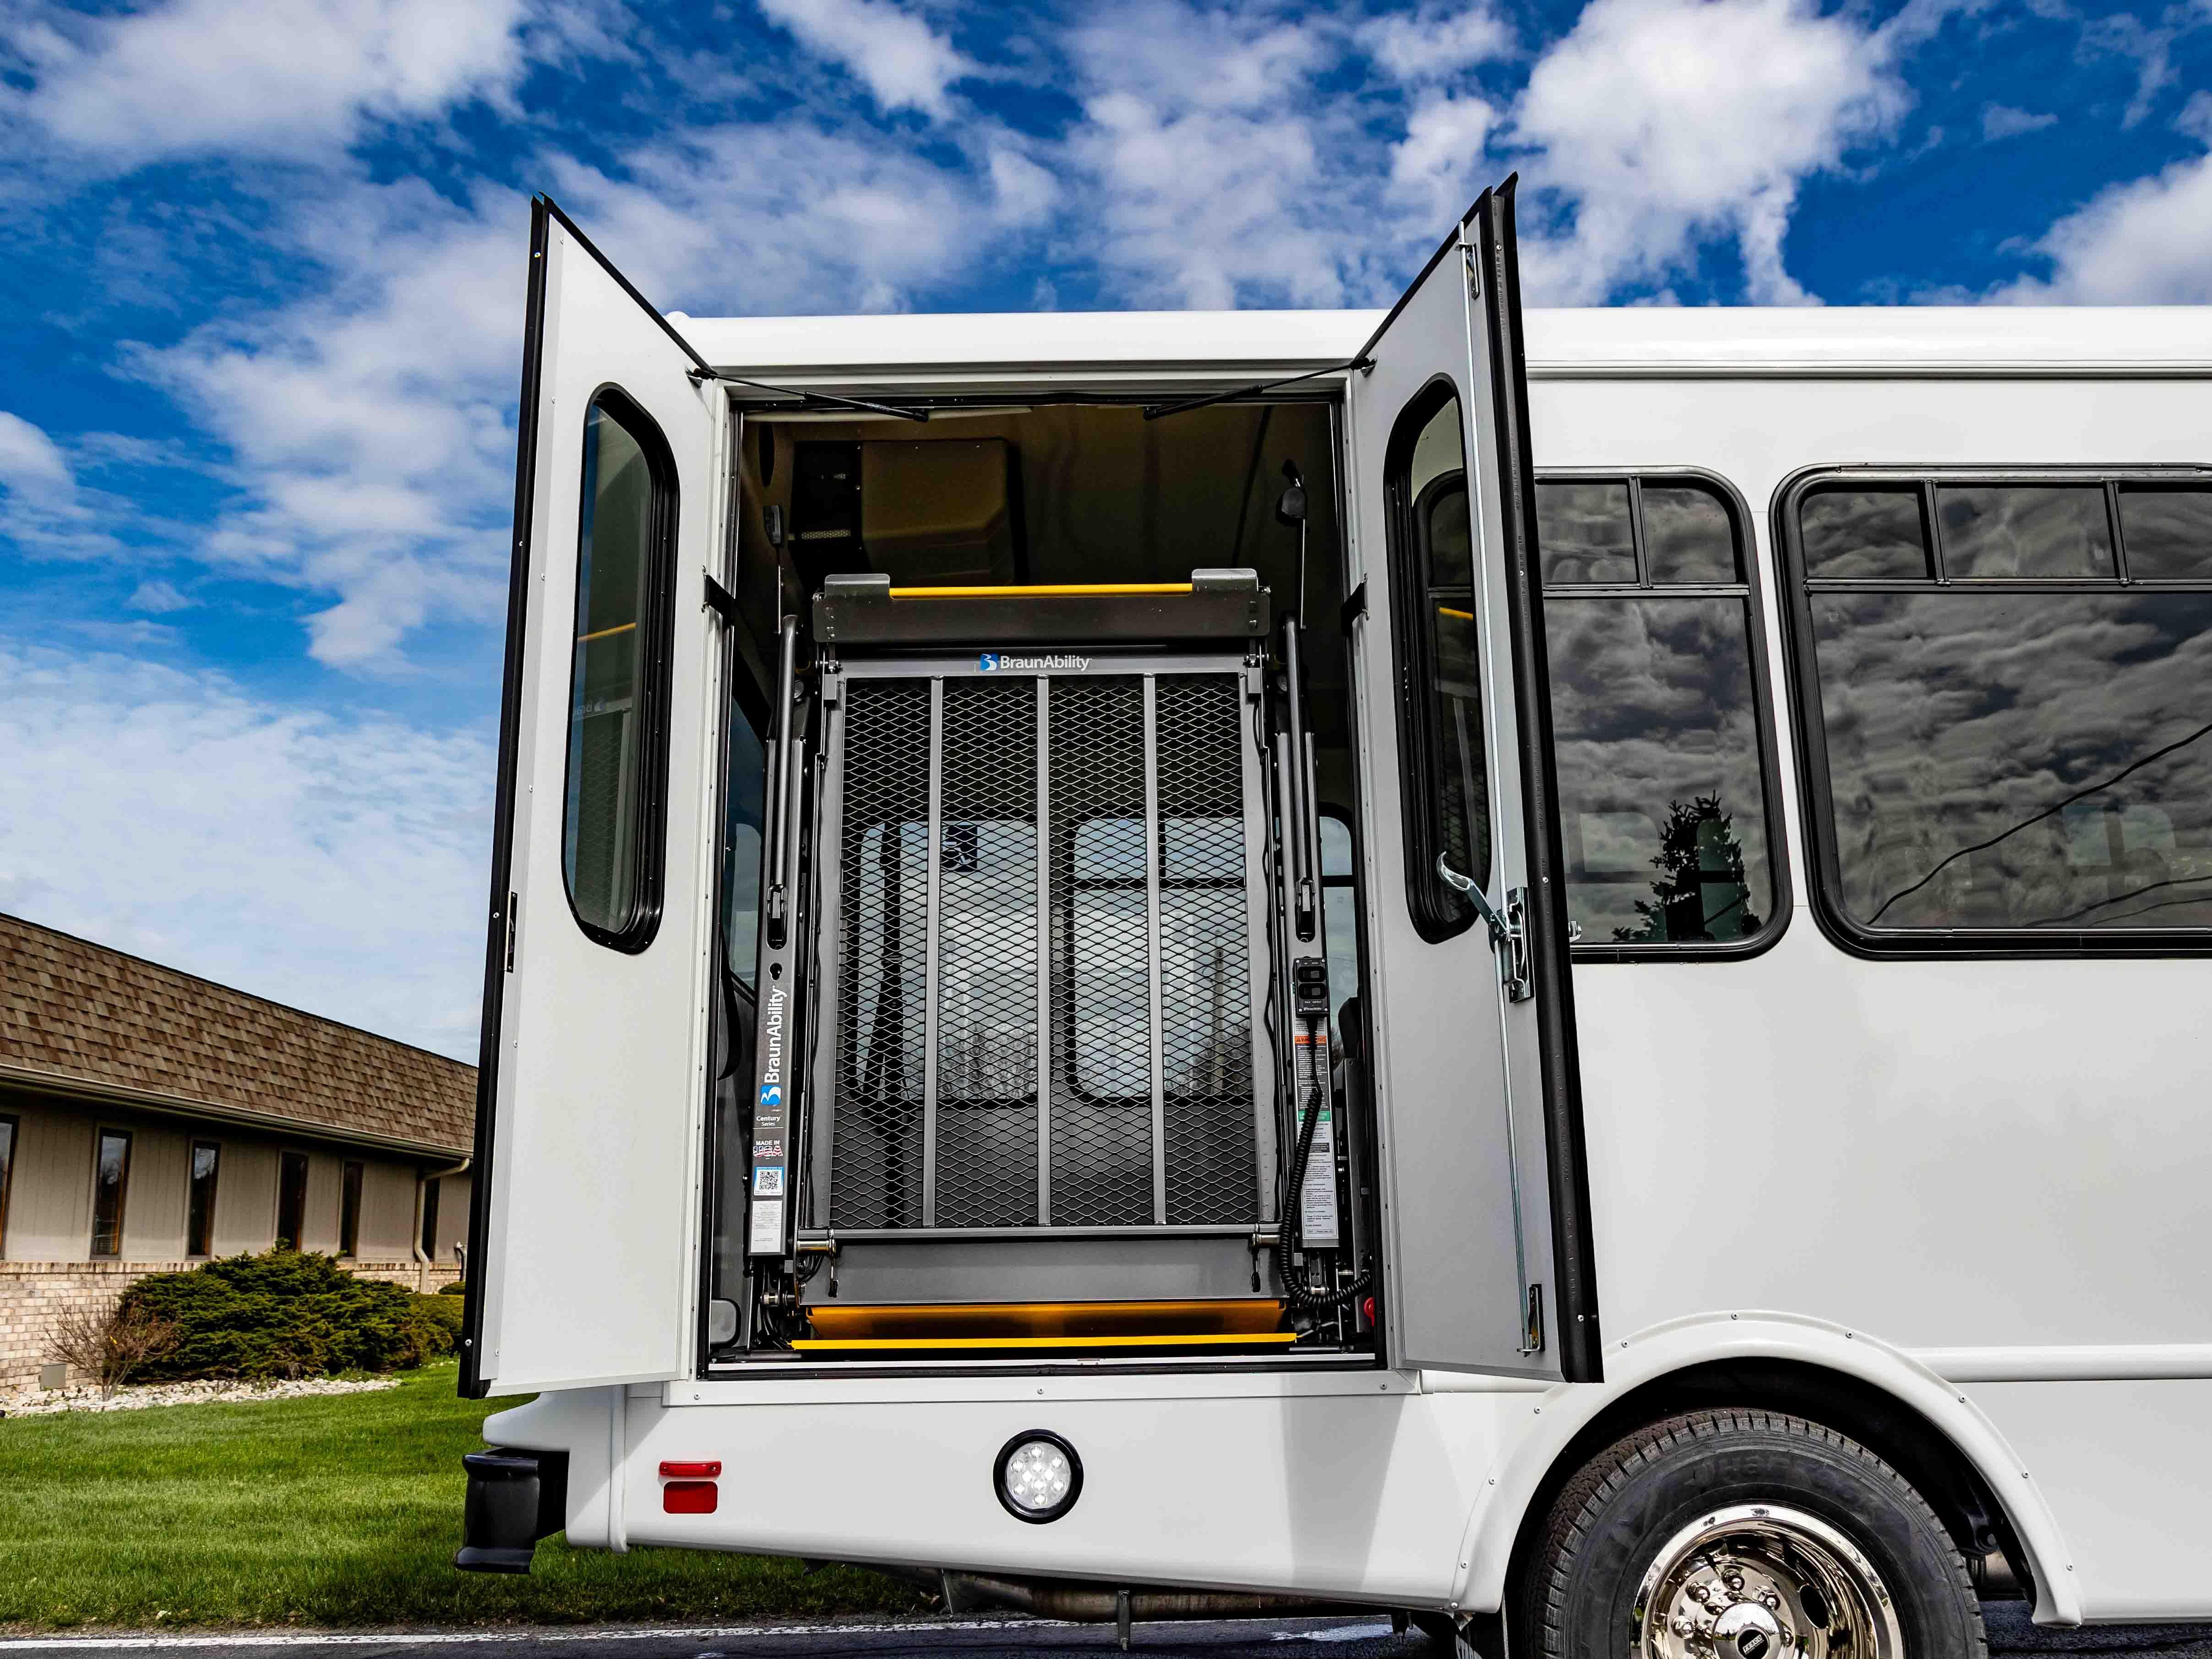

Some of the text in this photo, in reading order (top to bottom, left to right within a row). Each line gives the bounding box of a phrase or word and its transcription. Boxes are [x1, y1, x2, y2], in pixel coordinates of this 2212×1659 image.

[1000, 655, 1090, 671] BraunAbility
[764, 987, 787, 1083] BraunAbility
[753, 1145, 784, 1158] USA
